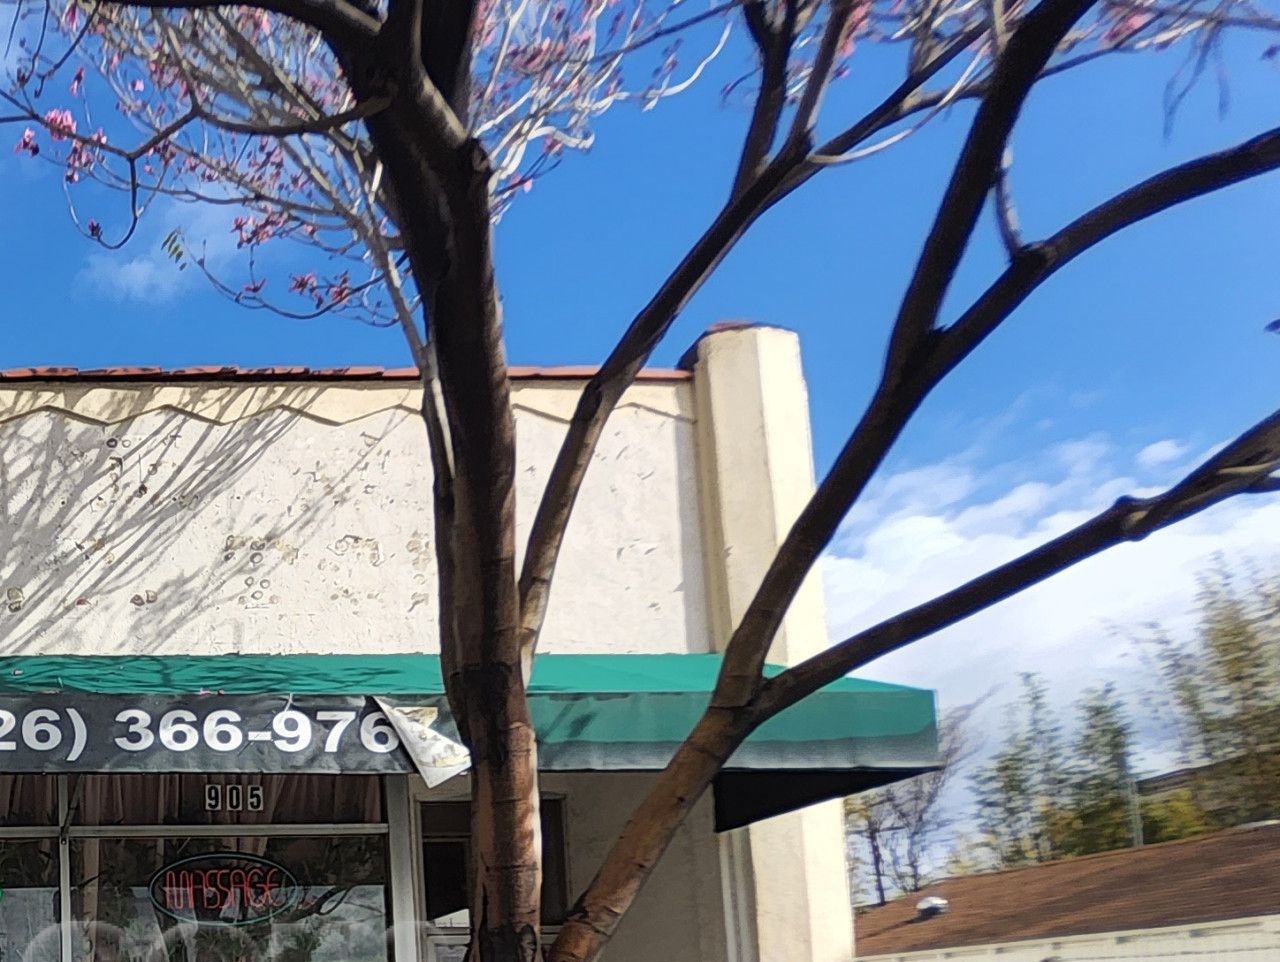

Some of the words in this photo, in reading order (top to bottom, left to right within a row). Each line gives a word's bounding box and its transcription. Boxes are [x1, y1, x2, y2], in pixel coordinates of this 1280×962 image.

[114, 709, 401, 753] 366-976
[206, 785, 263, 810] 905
[165, 868, 280, 910] MASSAGE
